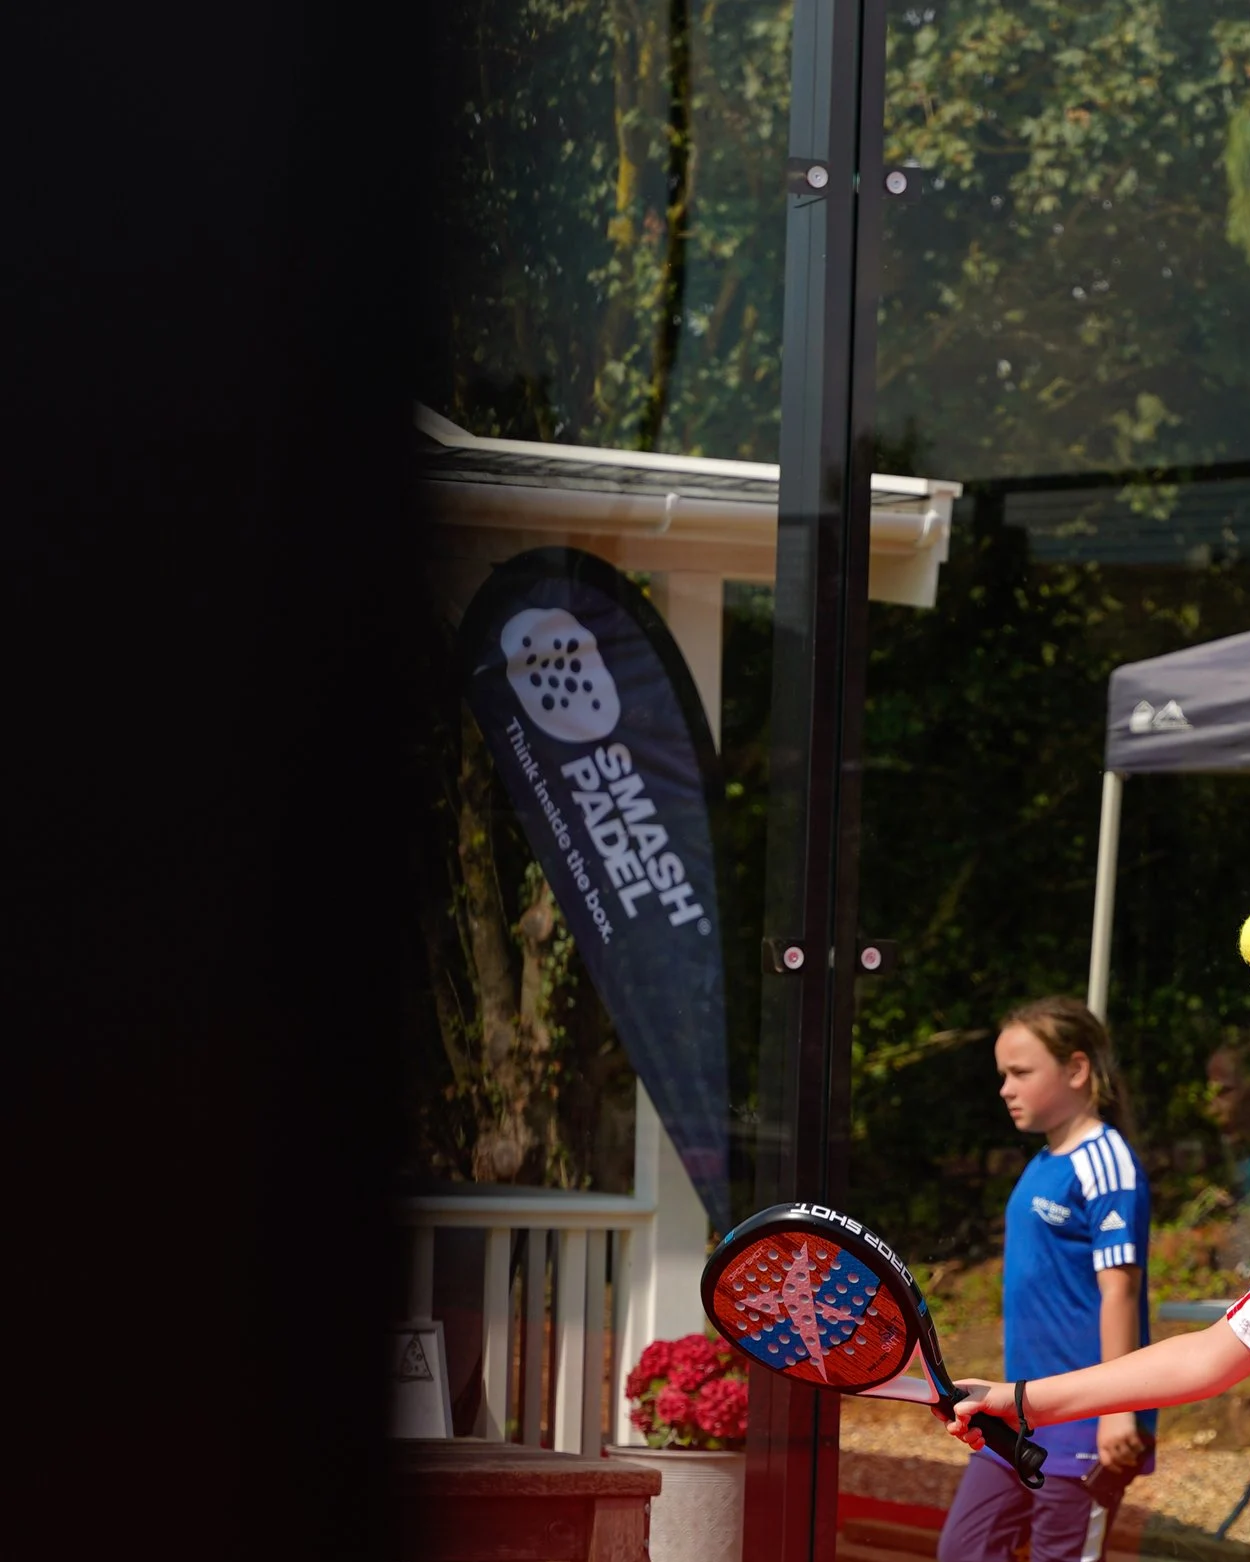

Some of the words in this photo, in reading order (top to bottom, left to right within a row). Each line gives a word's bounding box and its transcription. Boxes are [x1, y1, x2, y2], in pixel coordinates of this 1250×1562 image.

[506, 716, 539, 783] Think
[534, 779, 571, 850] inside
[566, 849, 591, 892] the
[585, 888, 614, 944] box.
[560, 755, 653, 919] PADEL
[594, 742, 705, 927] SMASH
[790, 1203, 864, 1236] SHOT
[863, 1233, 914, 1287] DROP
